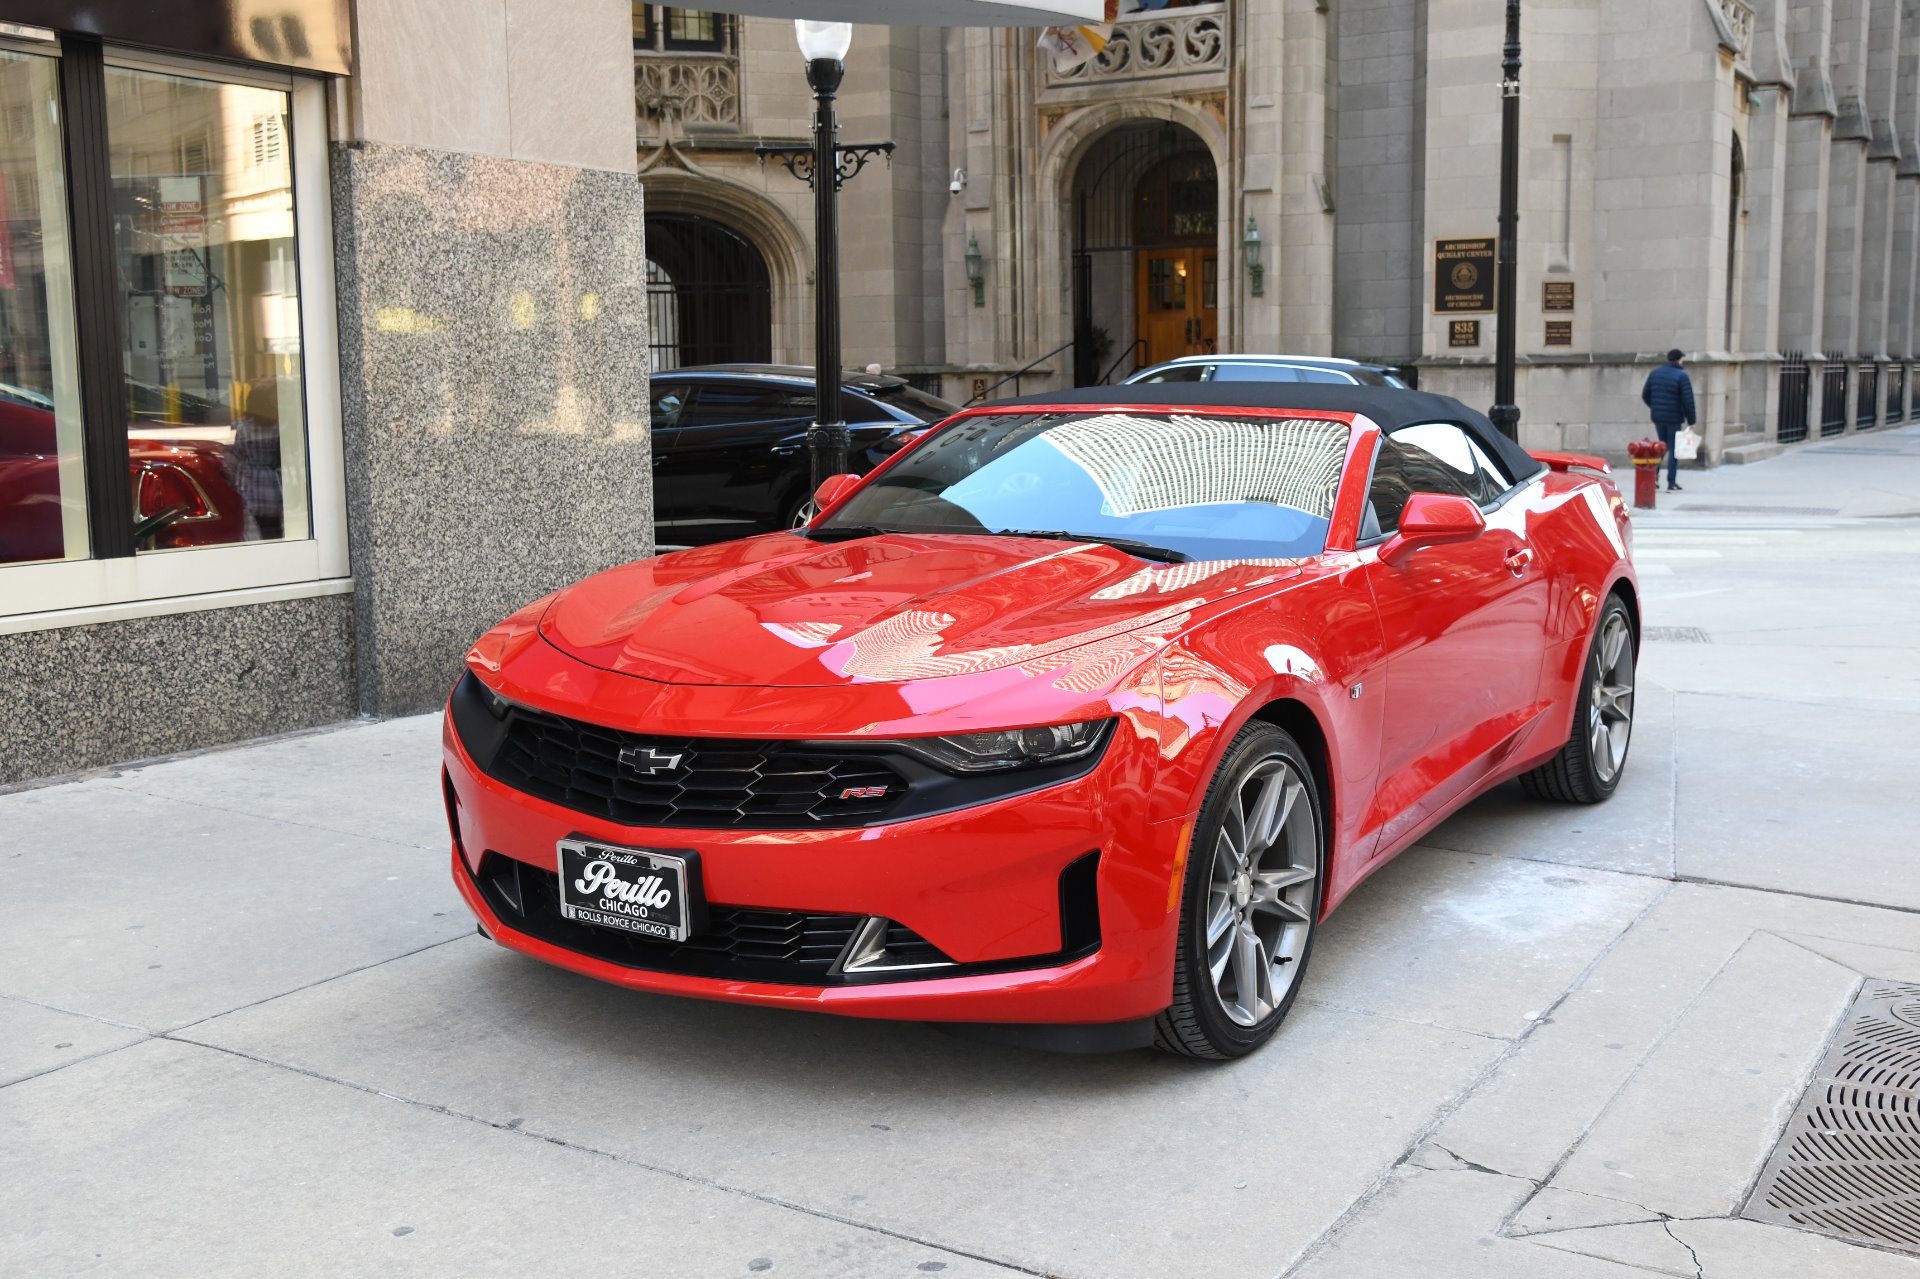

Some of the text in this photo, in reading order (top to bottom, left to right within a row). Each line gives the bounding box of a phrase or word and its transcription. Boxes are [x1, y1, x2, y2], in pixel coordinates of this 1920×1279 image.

[1466, 250, 1493, 258] CENTER
[1454, 322, 1474, 333] 835
[839, 785, 888, 799] RS
[598, 850, 638, 865] Perillo
[574, 860, 672, 909] Perillo
[599, 898, 648, 918] CHICAGO
[578, 909, 602, 923] ROLLS
[603, 916, 630, 929] ROYCE
[631, 921, 667, 936] CHICAGO
